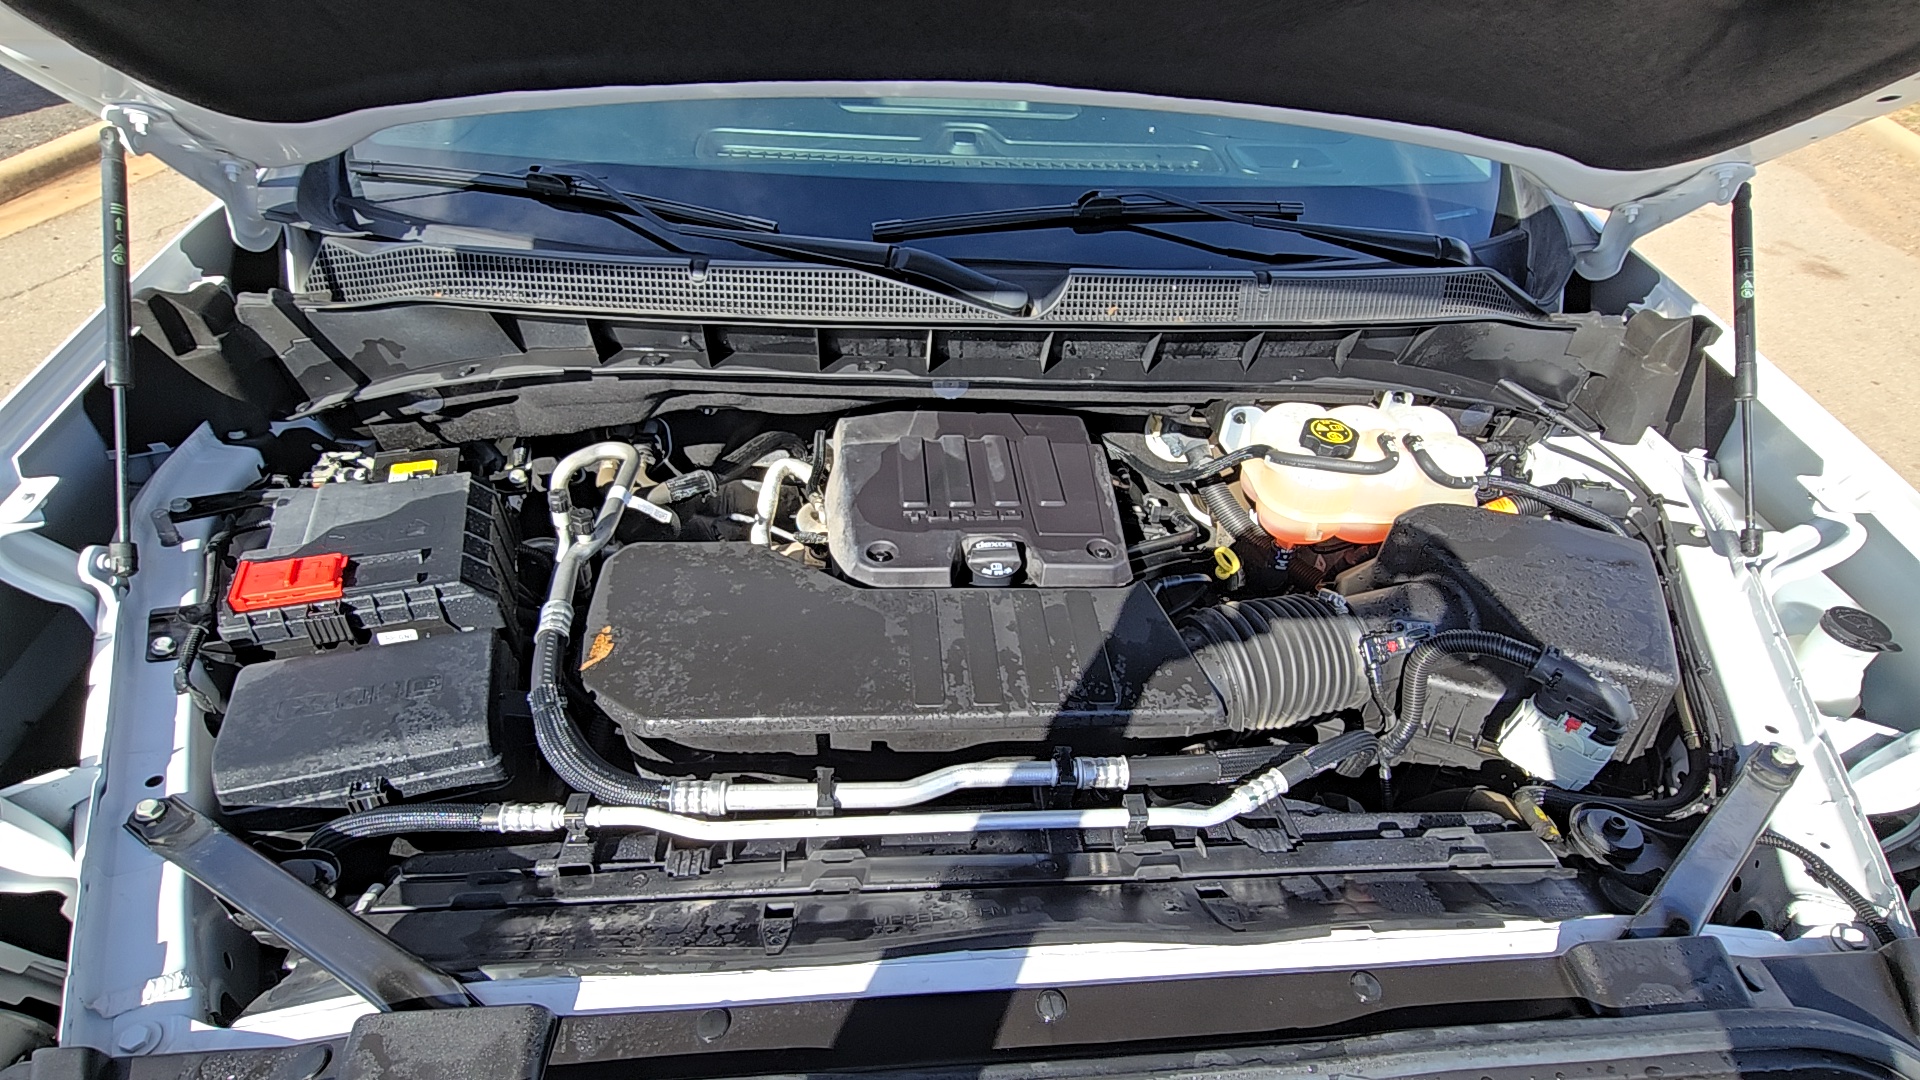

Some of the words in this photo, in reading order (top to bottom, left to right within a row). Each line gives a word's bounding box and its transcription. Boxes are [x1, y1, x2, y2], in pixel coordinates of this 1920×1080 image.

[902, 509, 1025, 525] TURBO
[975, 540, 1013, 549] dexos
[873, 910, 945, 926] UPPER
